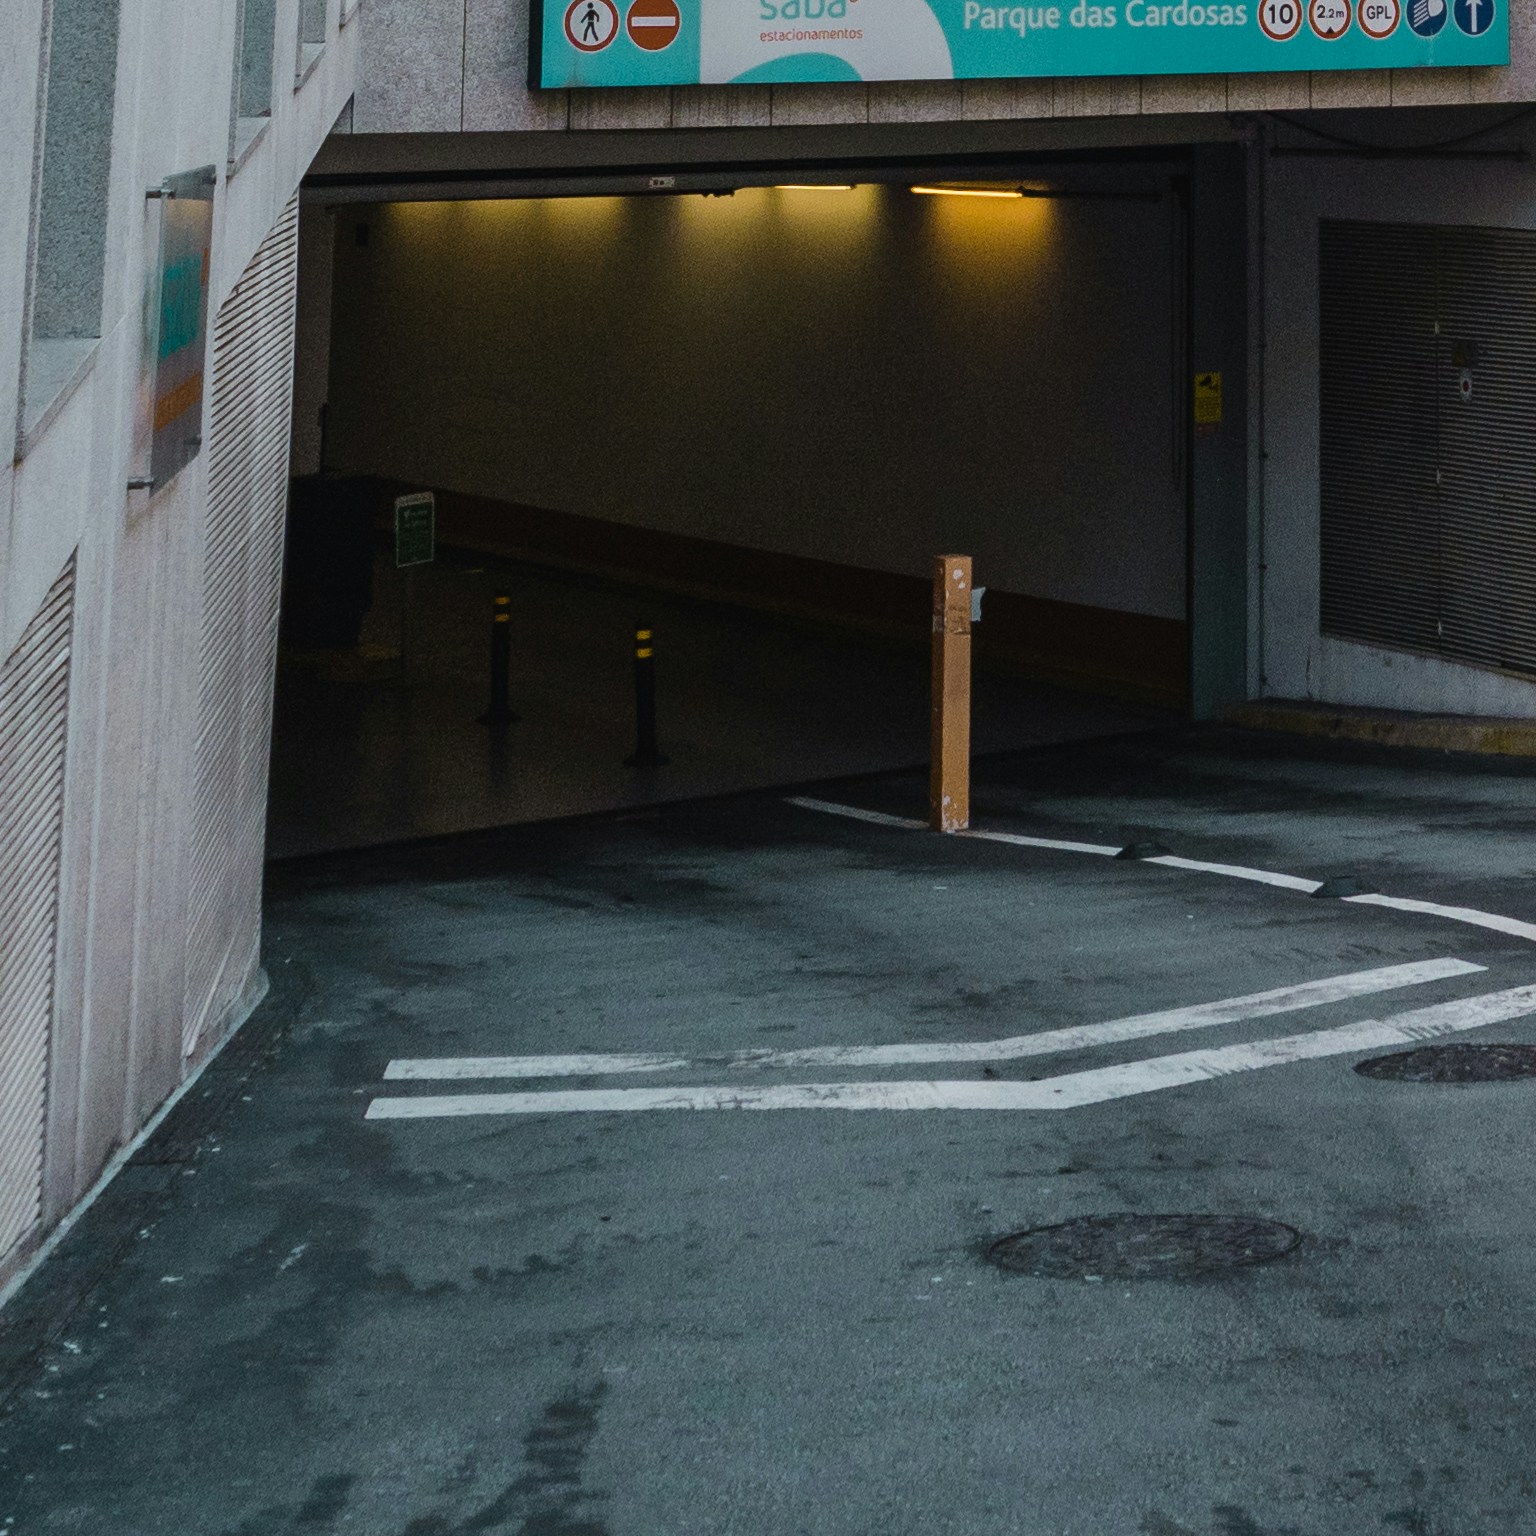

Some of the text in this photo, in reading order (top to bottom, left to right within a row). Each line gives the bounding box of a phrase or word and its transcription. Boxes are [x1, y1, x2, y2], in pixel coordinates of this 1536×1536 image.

[964, 0, 1060, 38] Parque
[1268, 3, 1294, 24] 10
[1366, 5, 1392, 20] GPL
[760, 29, 863, 42] estacionamentos
